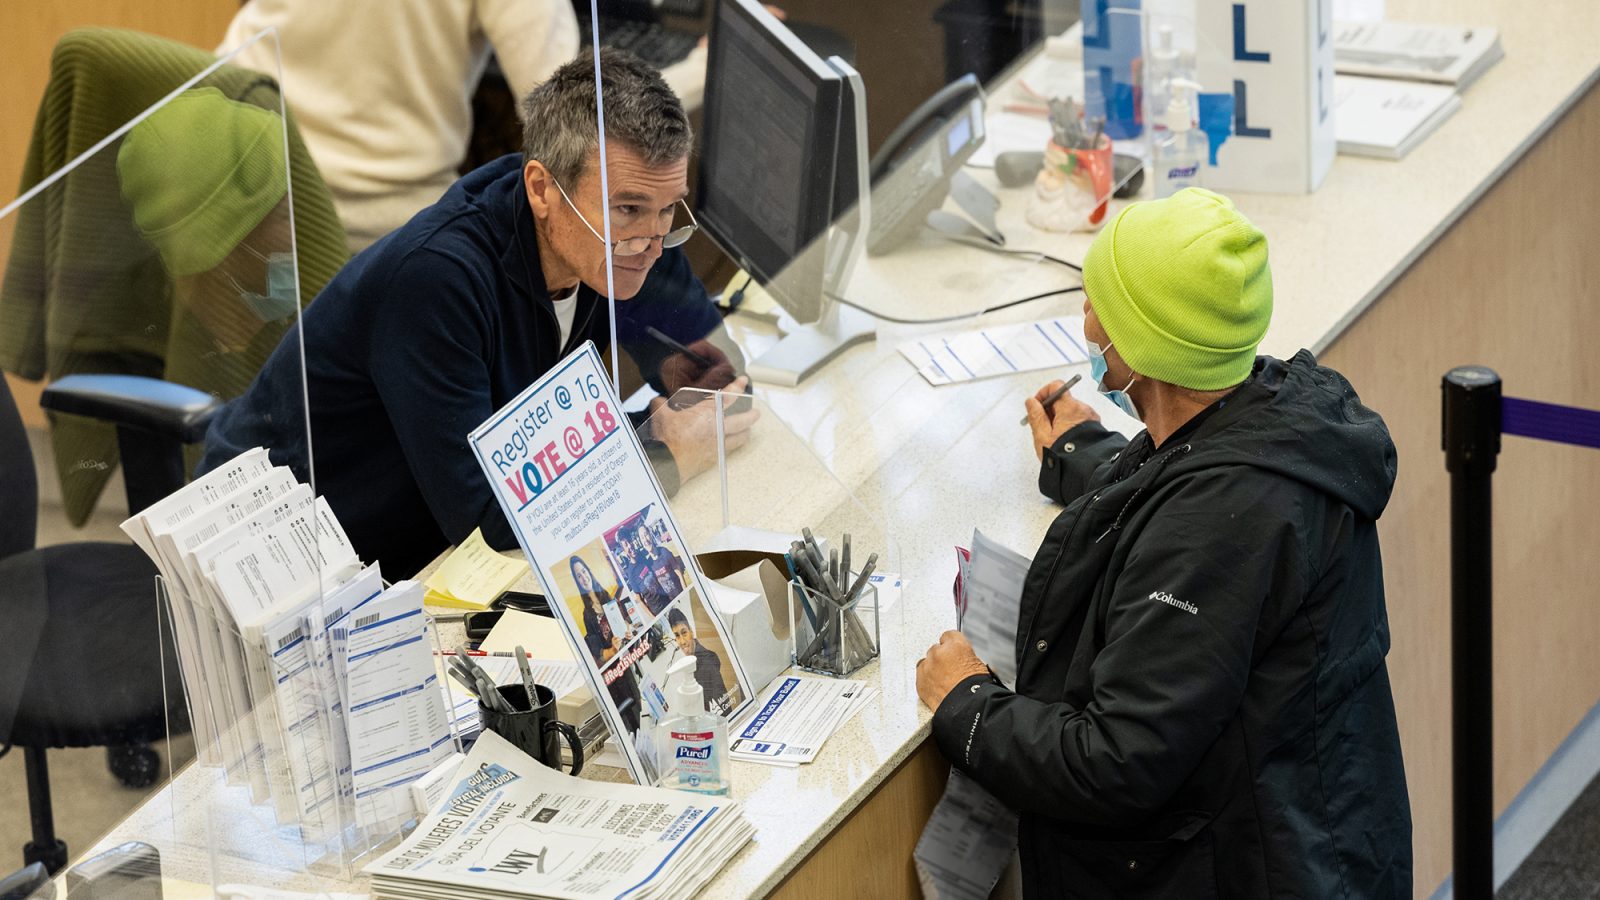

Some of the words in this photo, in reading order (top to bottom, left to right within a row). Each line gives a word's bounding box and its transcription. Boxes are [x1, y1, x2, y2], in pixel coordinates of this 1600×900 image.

[490, 398, 552, 475] Register
[555, 386, 572, 409] @
[575, 374, 599, 401] 16
[504, 440, 565, 504] VOTE
[563, 426, 585, 457] @
[584, 401, 615, 444] 18
[533, 507, 544, 519] YOU
[544, 500, 552, 510] are
[552, 494, 558, 503] at
[558, 486, 568, 498] least
[568, 478, 575, 488] 16
[576, 471, 588, 486] years
[601, 447, 617, 461] citizen
[617, 440, 622, 448] of
[533, 525, 543, 536] the
[541, 511, 559, 528] United
[558, 499, 573, 514] States
[573, 491, 582, 502] and
[586, 472, 603, 490] resident
[604, 466, 609, 475] of
[609, 452, 629, 470] Oregon
[551, 527, 562, 539] you
[561, 518, 570, 529] can
[570, 503, 586, 520] register
[586, 497, 592, 505] to
[592, 490, 604, 501] vote
[603, 472, 622, 490] TODAY!
[1155, 591, 1199, 615] Columbia
[412, 817, 464, 856] MUJERES
[458, 833, 483, 851] DEL
[477, 801, 517, 836] VOTANTE
[488, 847, 541, 875] LWV
